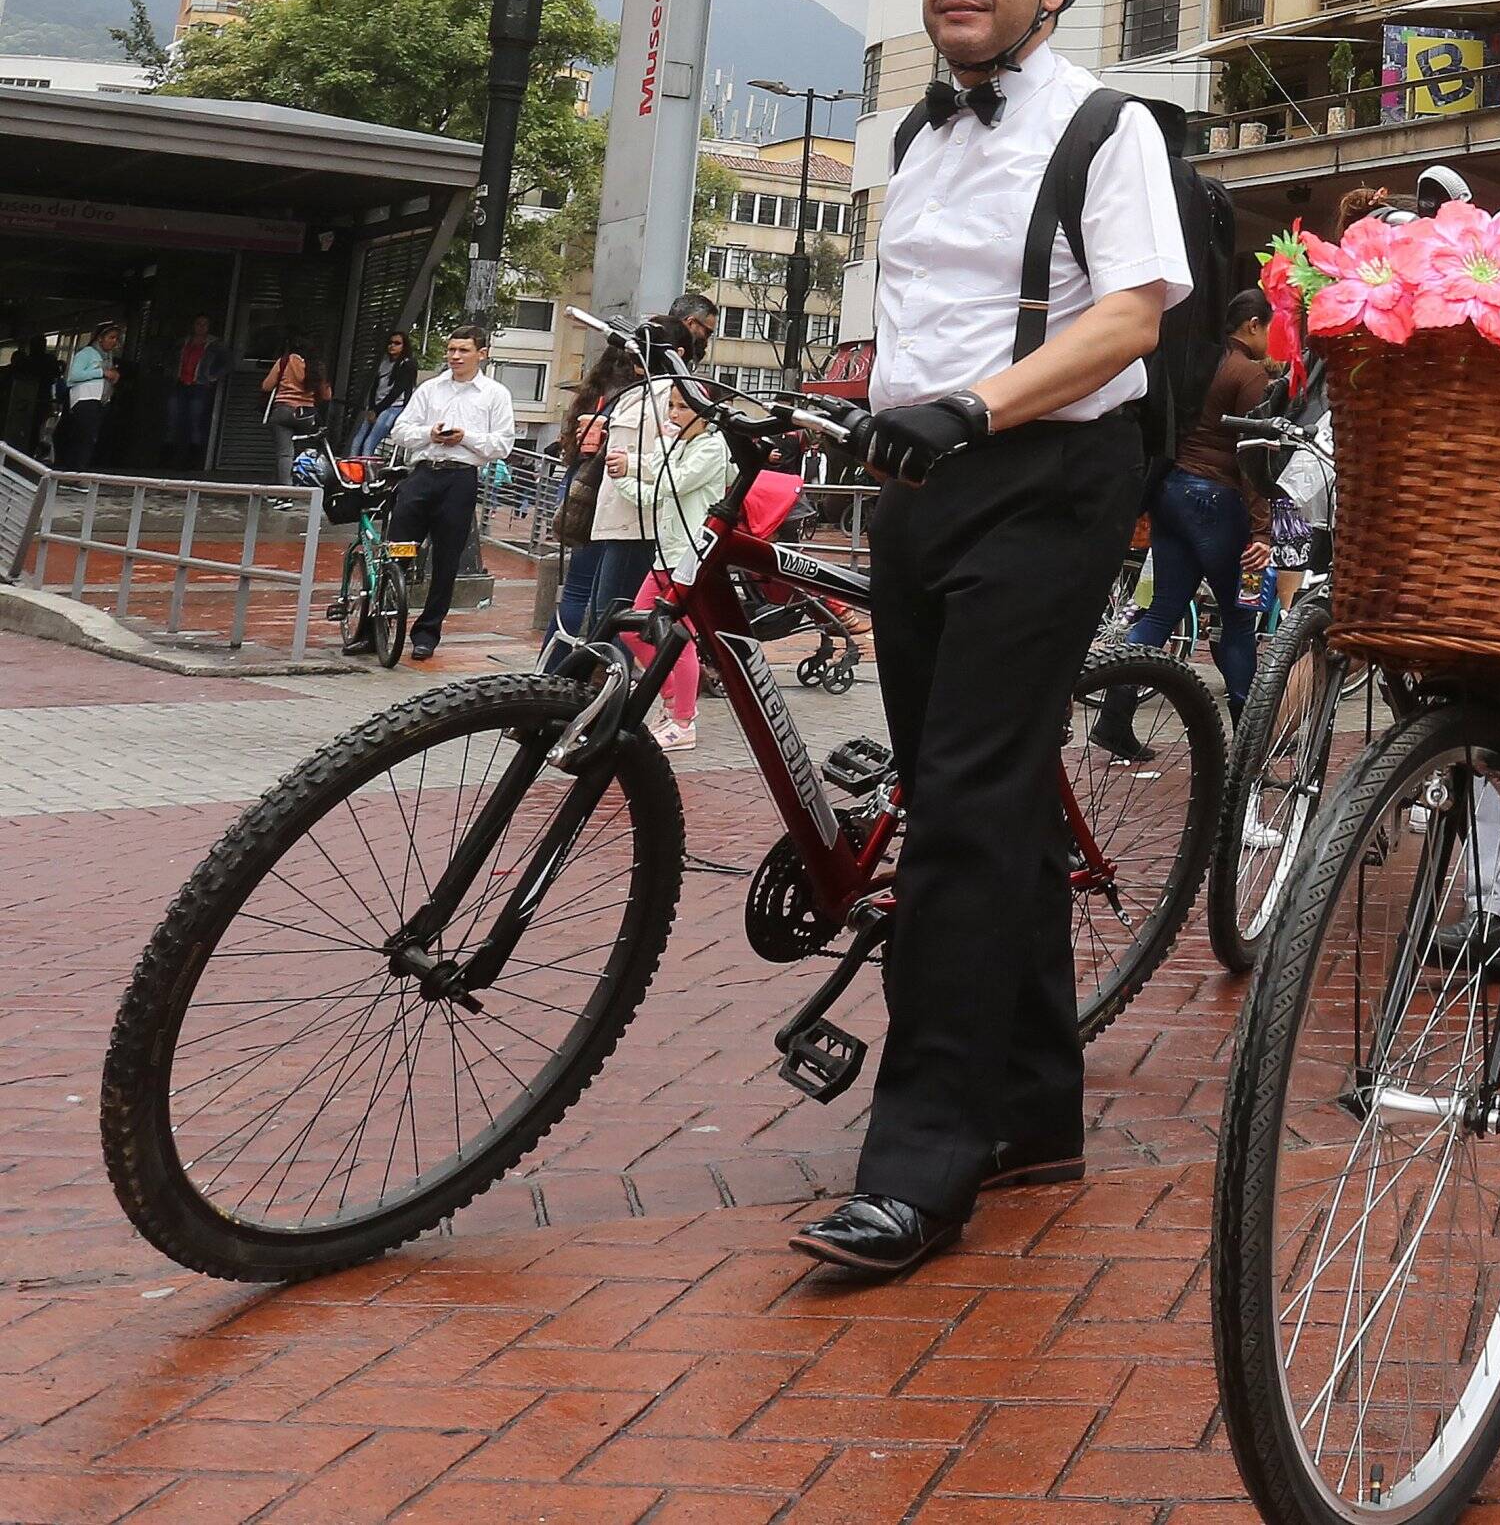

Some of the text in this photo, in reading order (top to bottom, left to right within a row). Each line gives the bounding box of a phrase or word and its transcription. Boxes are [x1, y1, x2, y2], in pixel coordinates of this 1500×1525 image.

[47, 202, 77, 218] del
[82, 205, 115, 221] Oro
[783, 552, 818, 578] MTB
